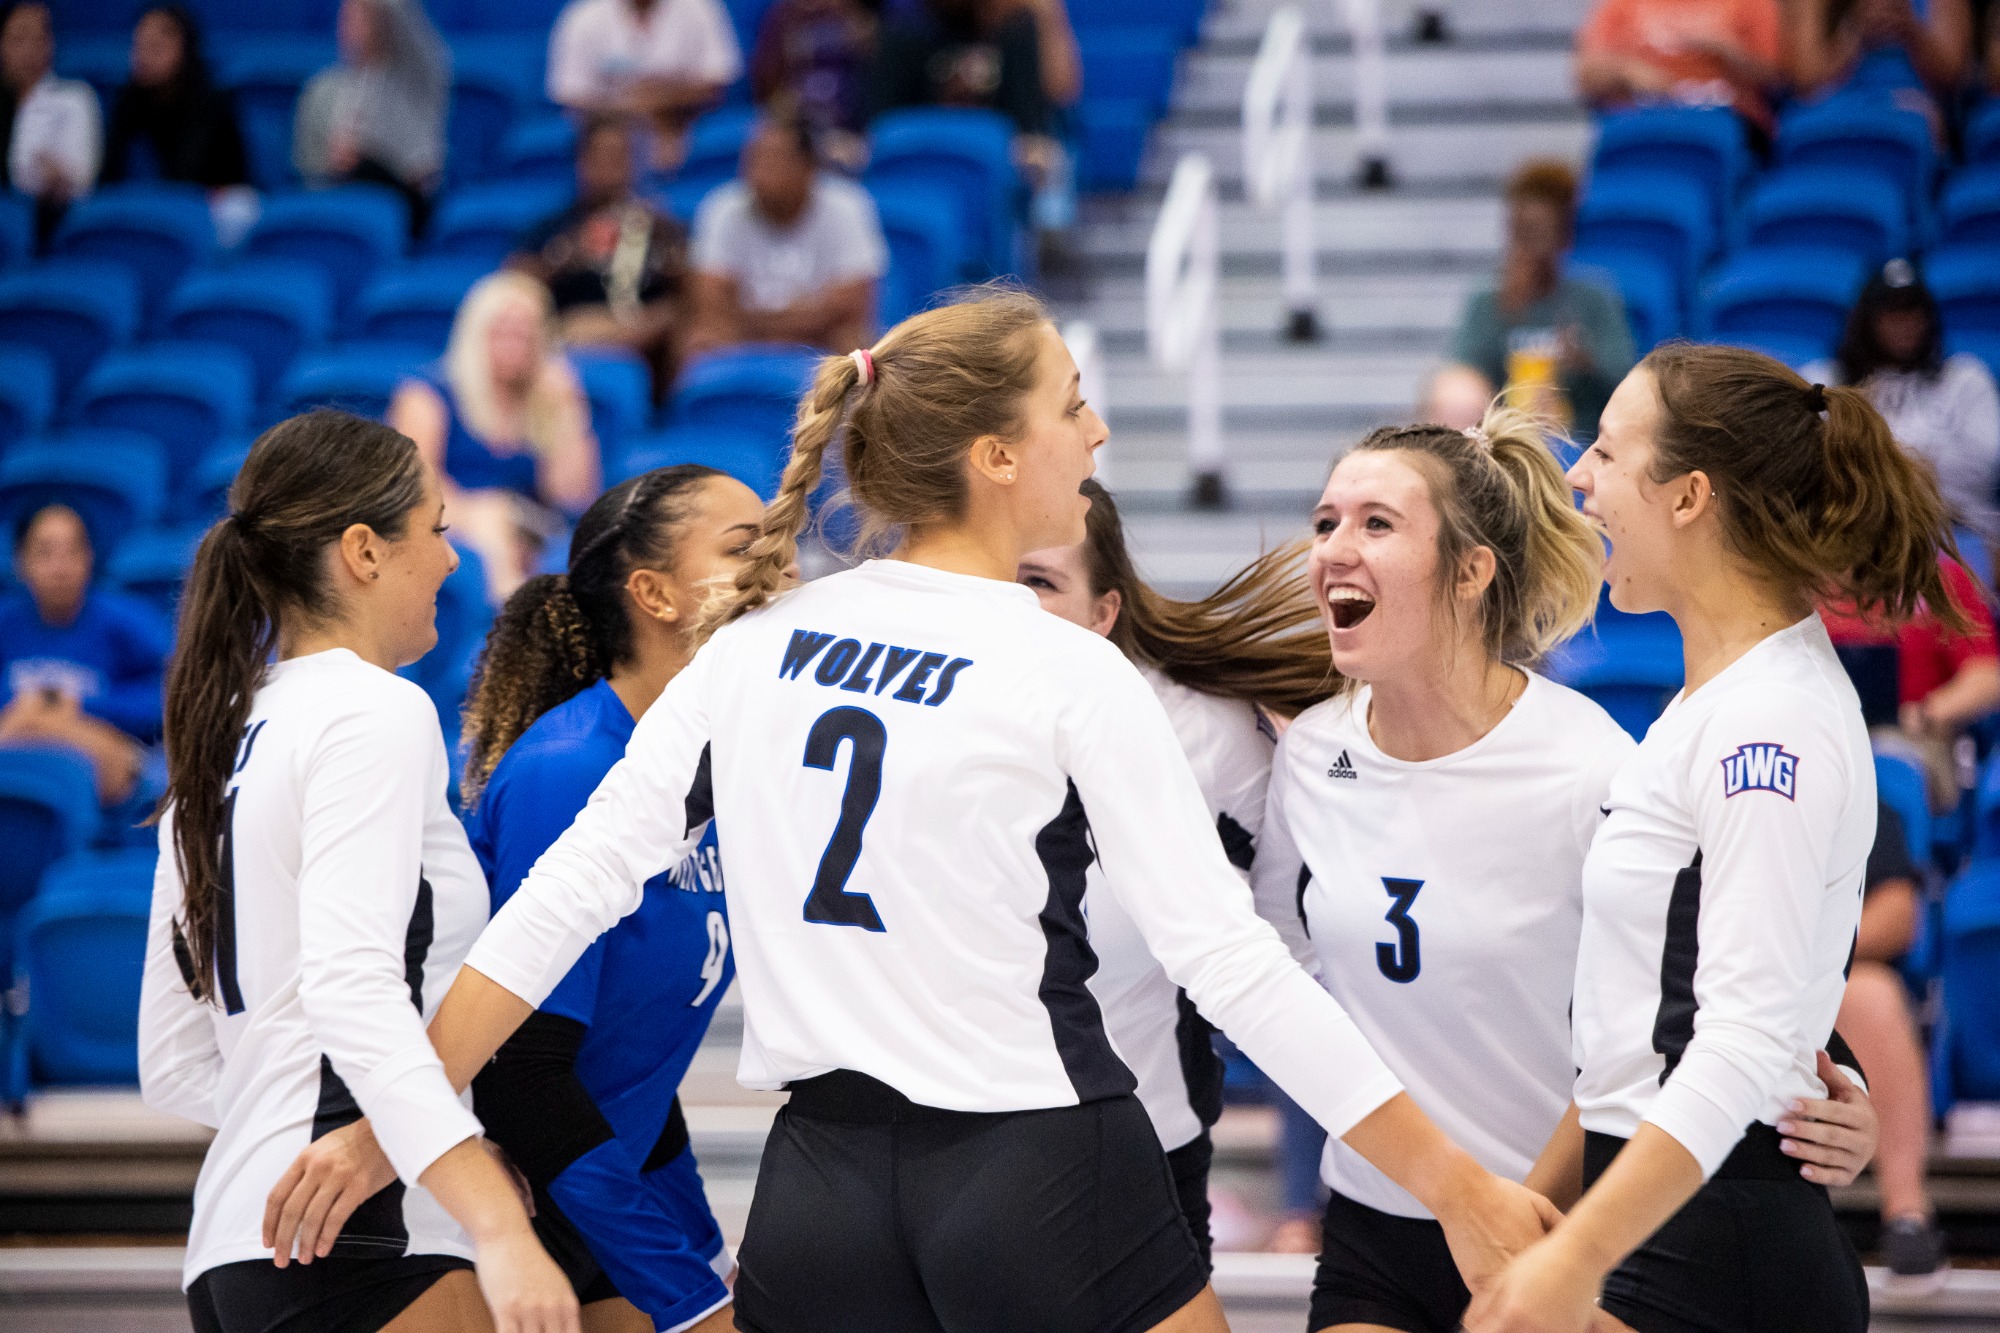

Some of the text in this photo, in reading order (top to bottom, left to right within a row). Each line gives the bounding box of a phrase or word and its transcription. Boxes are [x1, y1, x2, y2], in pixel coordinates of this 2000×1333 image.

[779, 628, 974, 707] WOLVES
[1328, 767, 1358, 779] adidas
[1724, 745, 1794, 797] UWG
[802, 705, 888, 933] 2
[690, 910, 730, 1007] 9
[1375, 876, 1426, 984] 3
